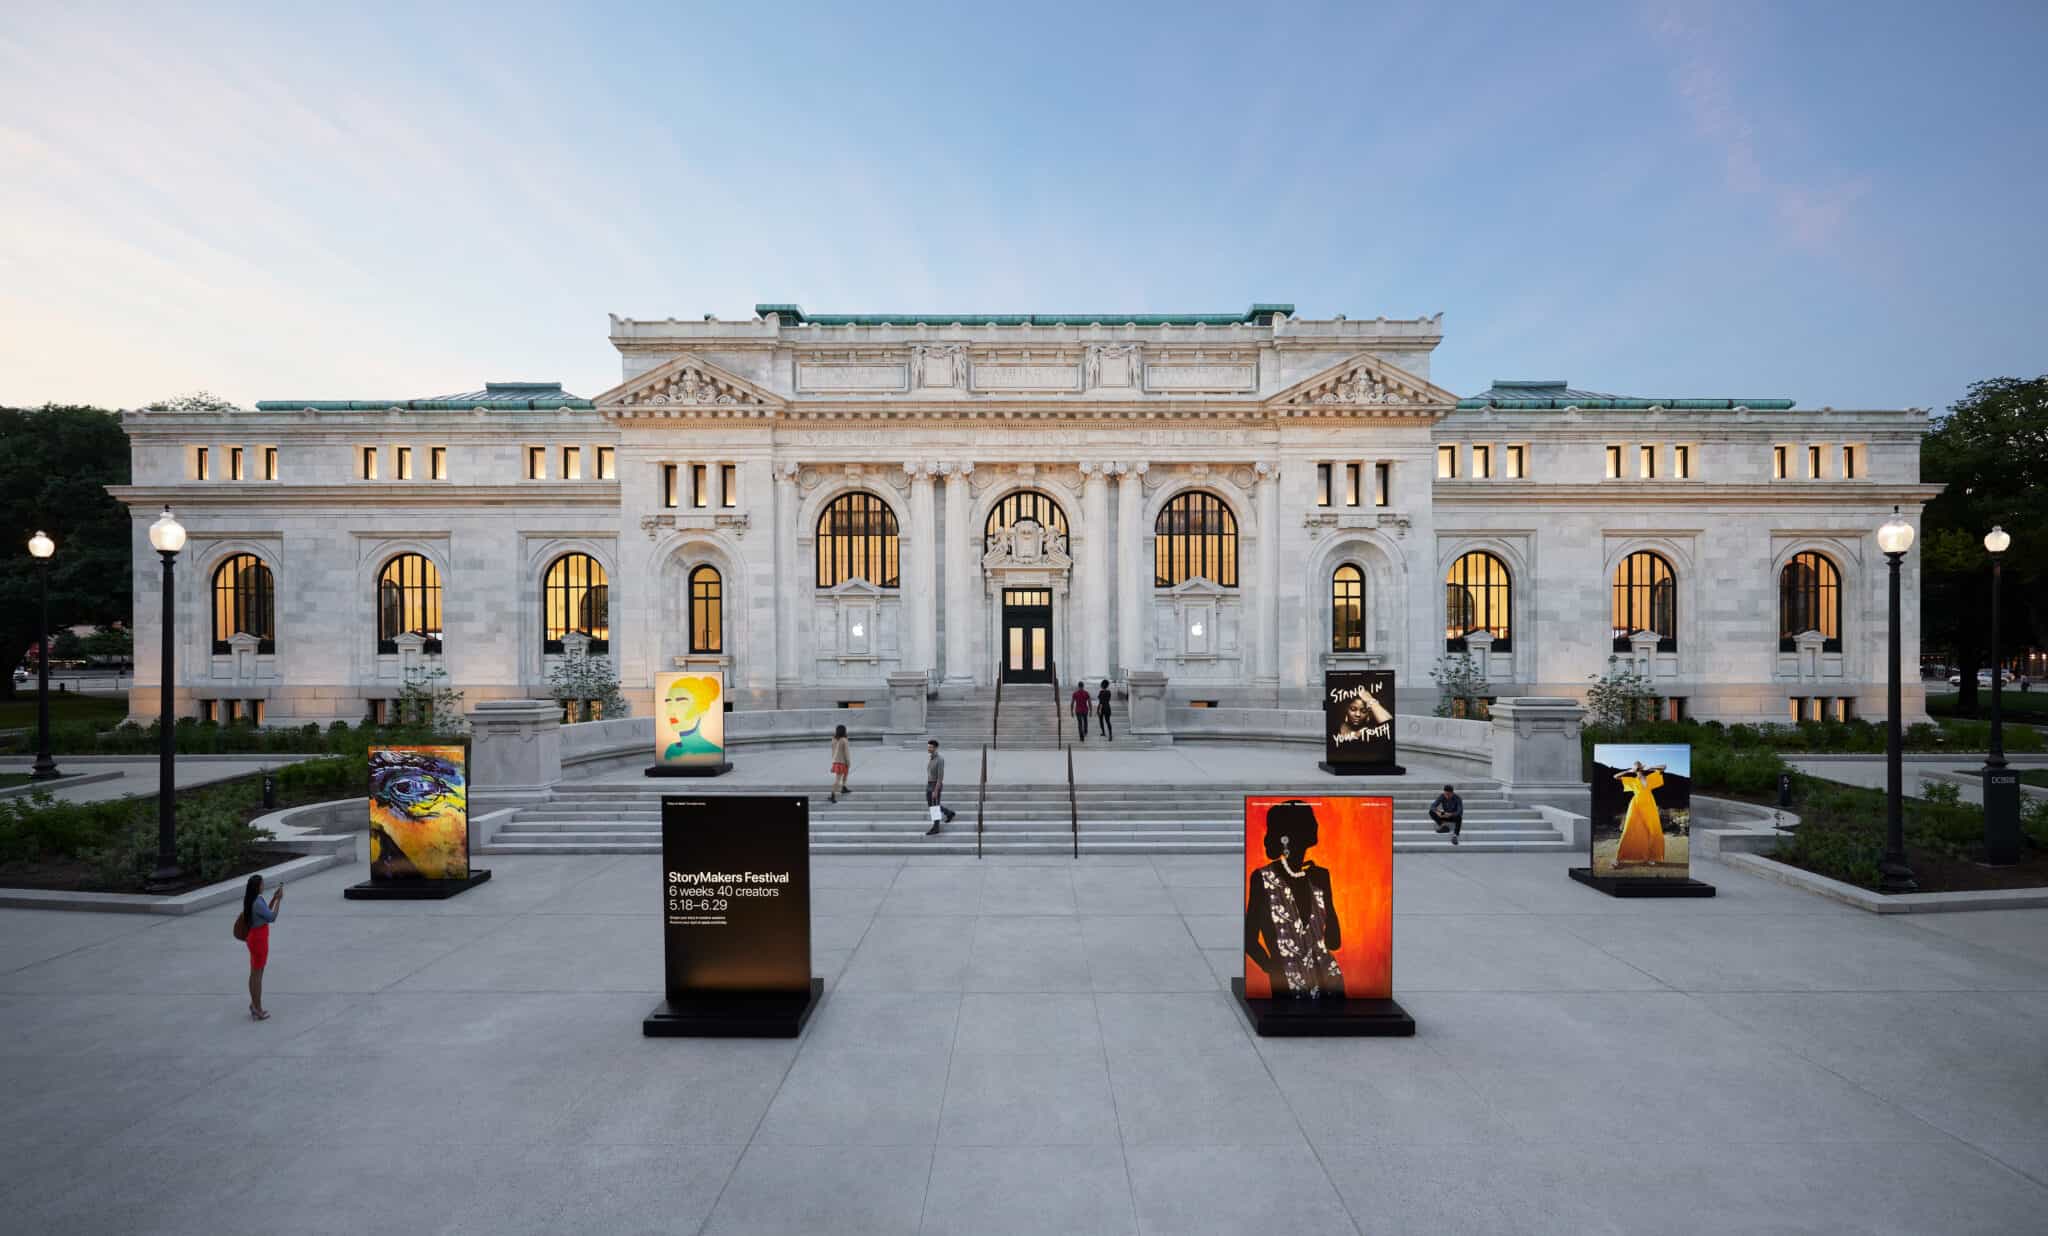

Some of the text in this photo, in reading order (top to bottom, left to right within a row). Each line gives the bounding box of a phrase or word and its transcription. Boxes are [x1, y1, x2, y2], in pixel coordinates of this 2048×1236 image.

[1330, 681, 1383, 704] STAND IN
[1333, 732, 1359, 748] YOUR
[1360, 724, 1391, 743] TRUTH
[668, 872, 790, 885] StoryMakers Festival
[669, 886, 780, 897] 6 weeks 40 creators
